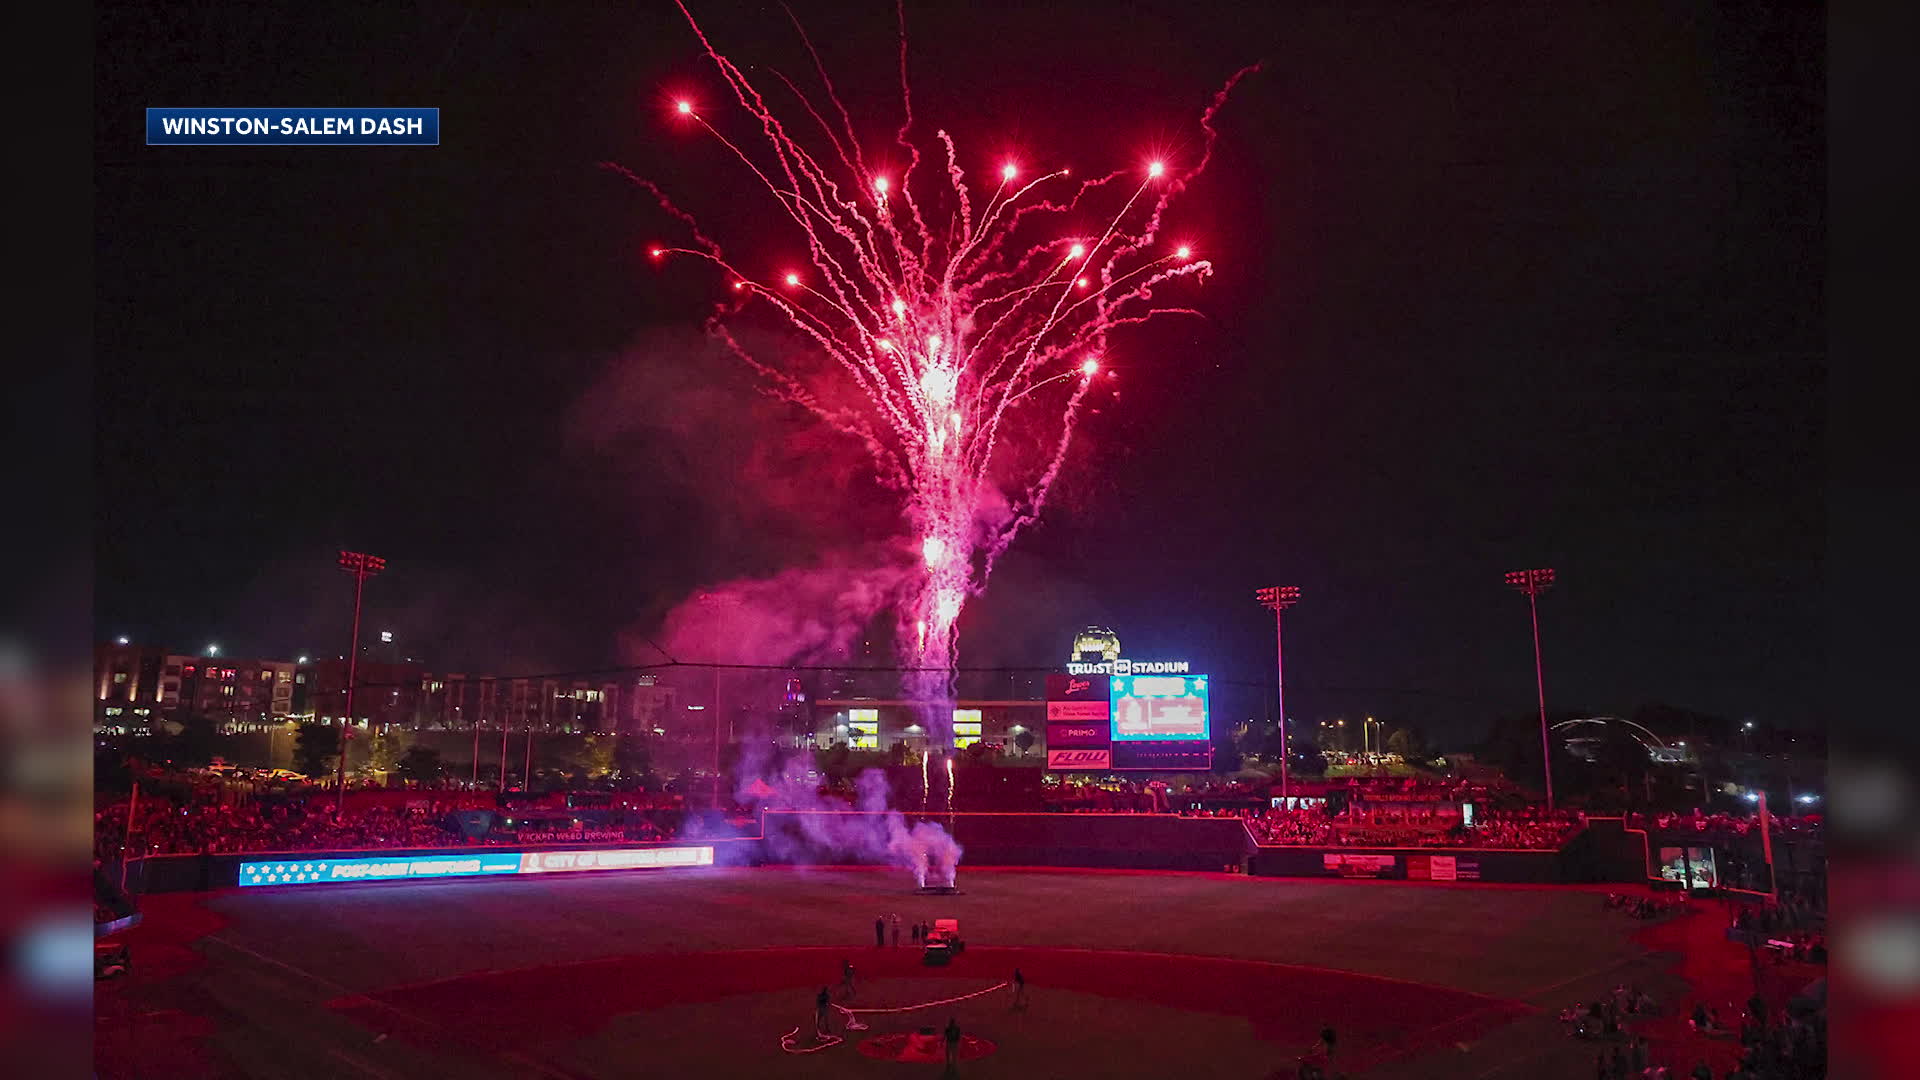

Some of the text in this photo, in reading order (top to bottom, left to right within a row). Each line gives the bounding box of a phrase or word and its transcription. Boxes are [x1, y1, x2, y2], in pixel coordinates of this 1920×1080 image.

[1067, 661, 1189, 675] TRUIST STADIUM
[1068, 729, 1096, 737] PRIMO
[1055, 752, 1108, 762] FLOW
